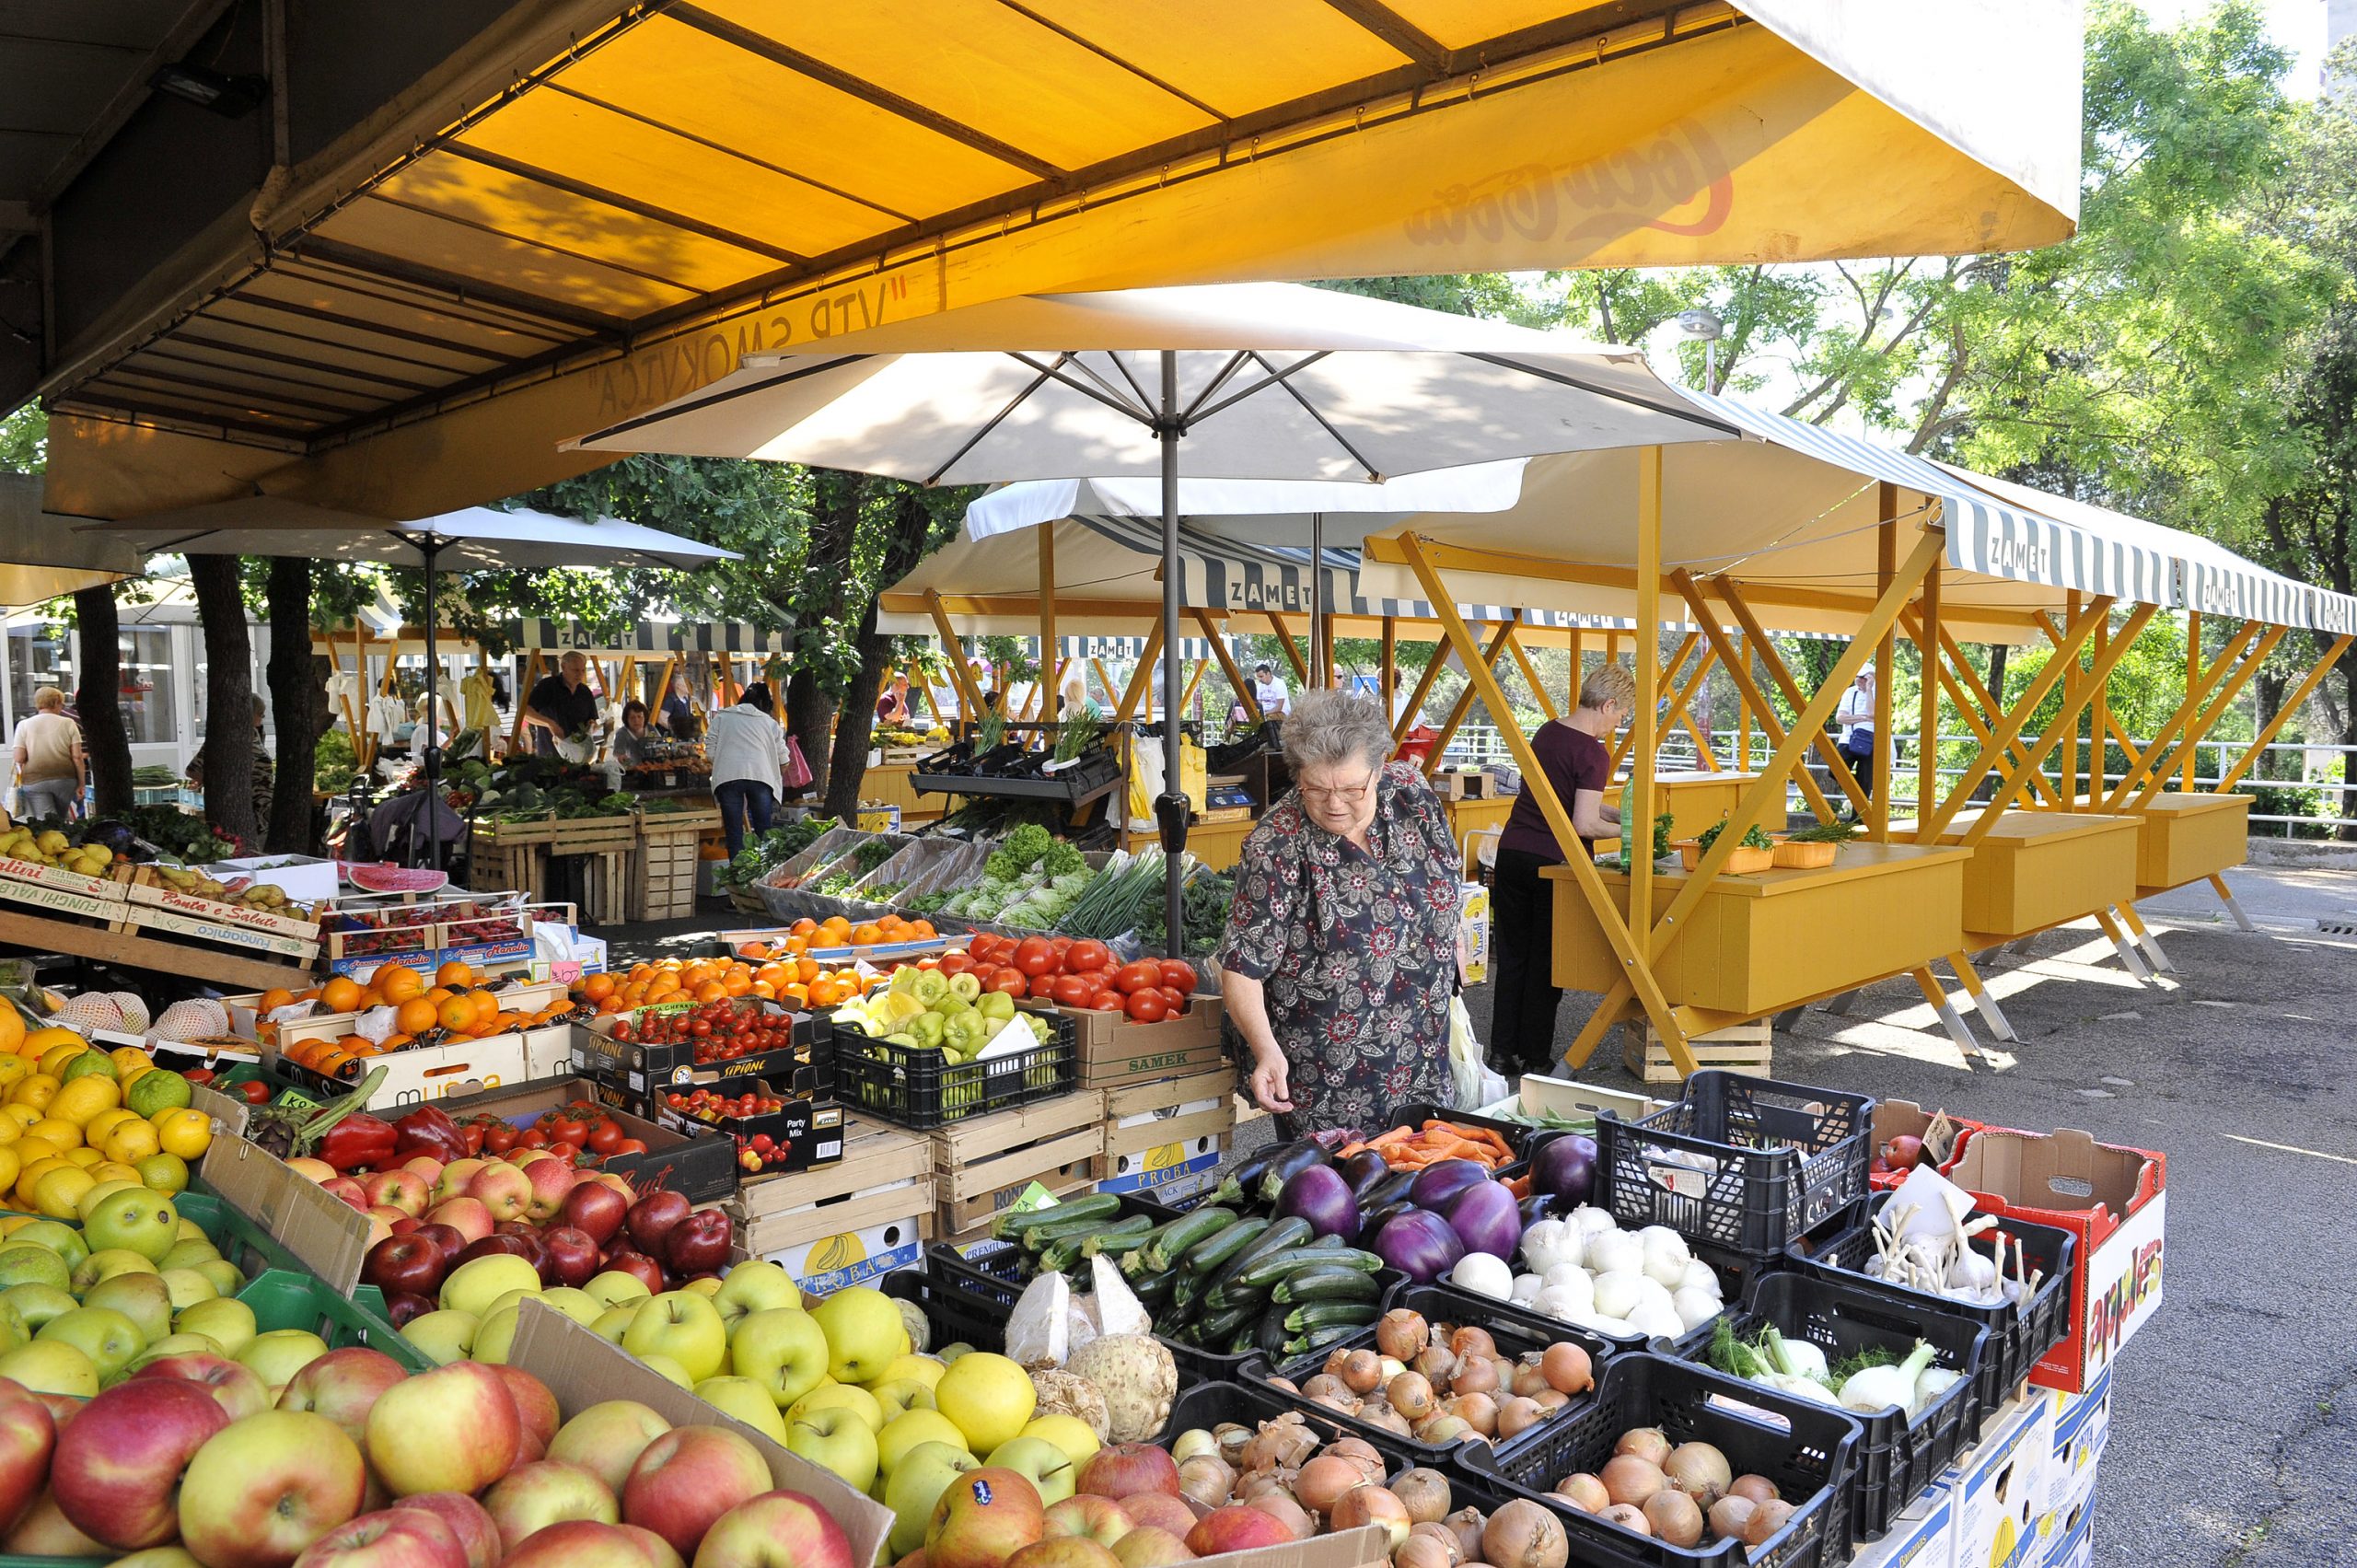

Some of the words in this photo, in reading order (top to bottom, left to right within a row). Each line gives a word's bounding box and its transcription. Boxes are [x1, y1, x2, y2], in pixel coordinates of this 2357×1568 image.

[1991, 537, 2047, 573] ZAMET
[1231, 582, 1311, 605] ZAMET
[2205, 585, 2235, 608] ZAMET
[1091, 645, 1131, 656] ZAMET
[214, 908, 222, 916] e
[226, 907, 278, 928] Salute
[197, 925, 271, 949] Fungamico
[485, 942, 529, 958] Manolio
[725, 1060, 766, 1076] SIPIONE
[1129, 1052, 1188, 1072] SAMEK
[787, 1119, 806, 1129] Party
[789, 1129, 803, 1138] Mix
[1138, 1163, 1190, 1187] PROBA
[2088, 1247, 2162, 1367] apples
